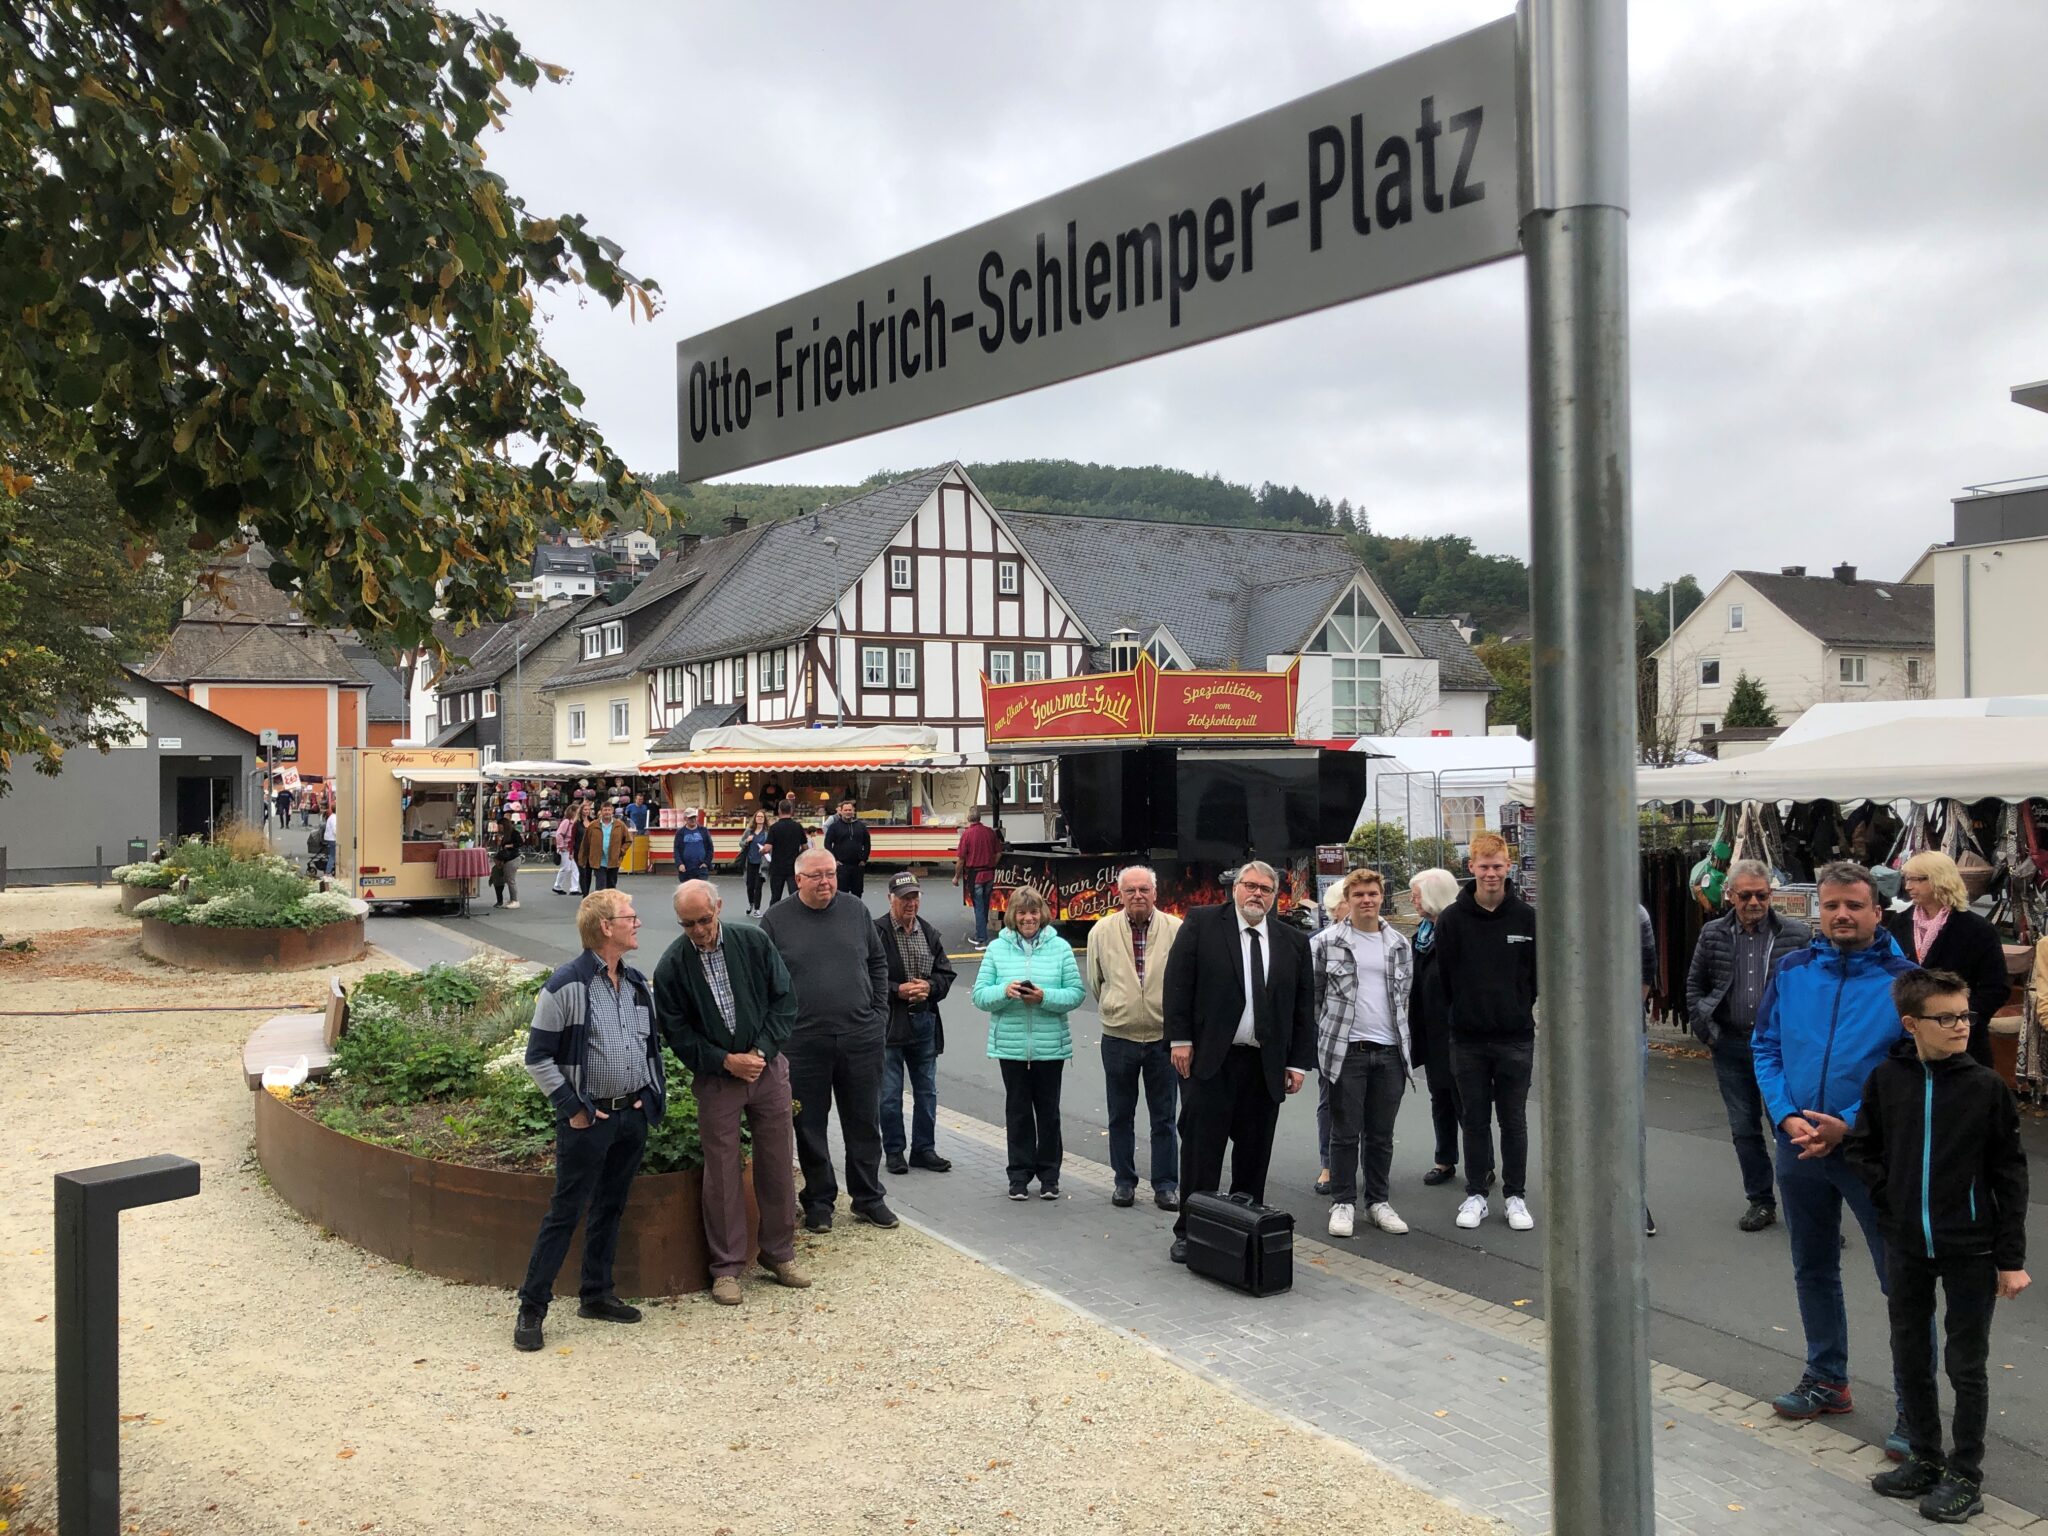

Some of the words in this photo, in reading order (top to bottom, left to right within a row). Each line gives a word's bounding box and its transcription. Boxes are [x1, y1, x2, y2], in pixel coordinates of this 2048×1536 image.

[688, 96, 1485, 444] Otto-Friedrich-Schlemper-Platz
[1183, 681, 1262, 704] Spezialitäten
[1030, 685, 1132, 730] Gourmet-Grill
[994, 717, 1007, 732] van
[1187, 713, 1257, 730] Holzkohlegrill
[993, 865, 1055, 904] met-Grill
[1059, 879, 1094, 897] van
[1068, 891, 1121, 918] Wetzla
